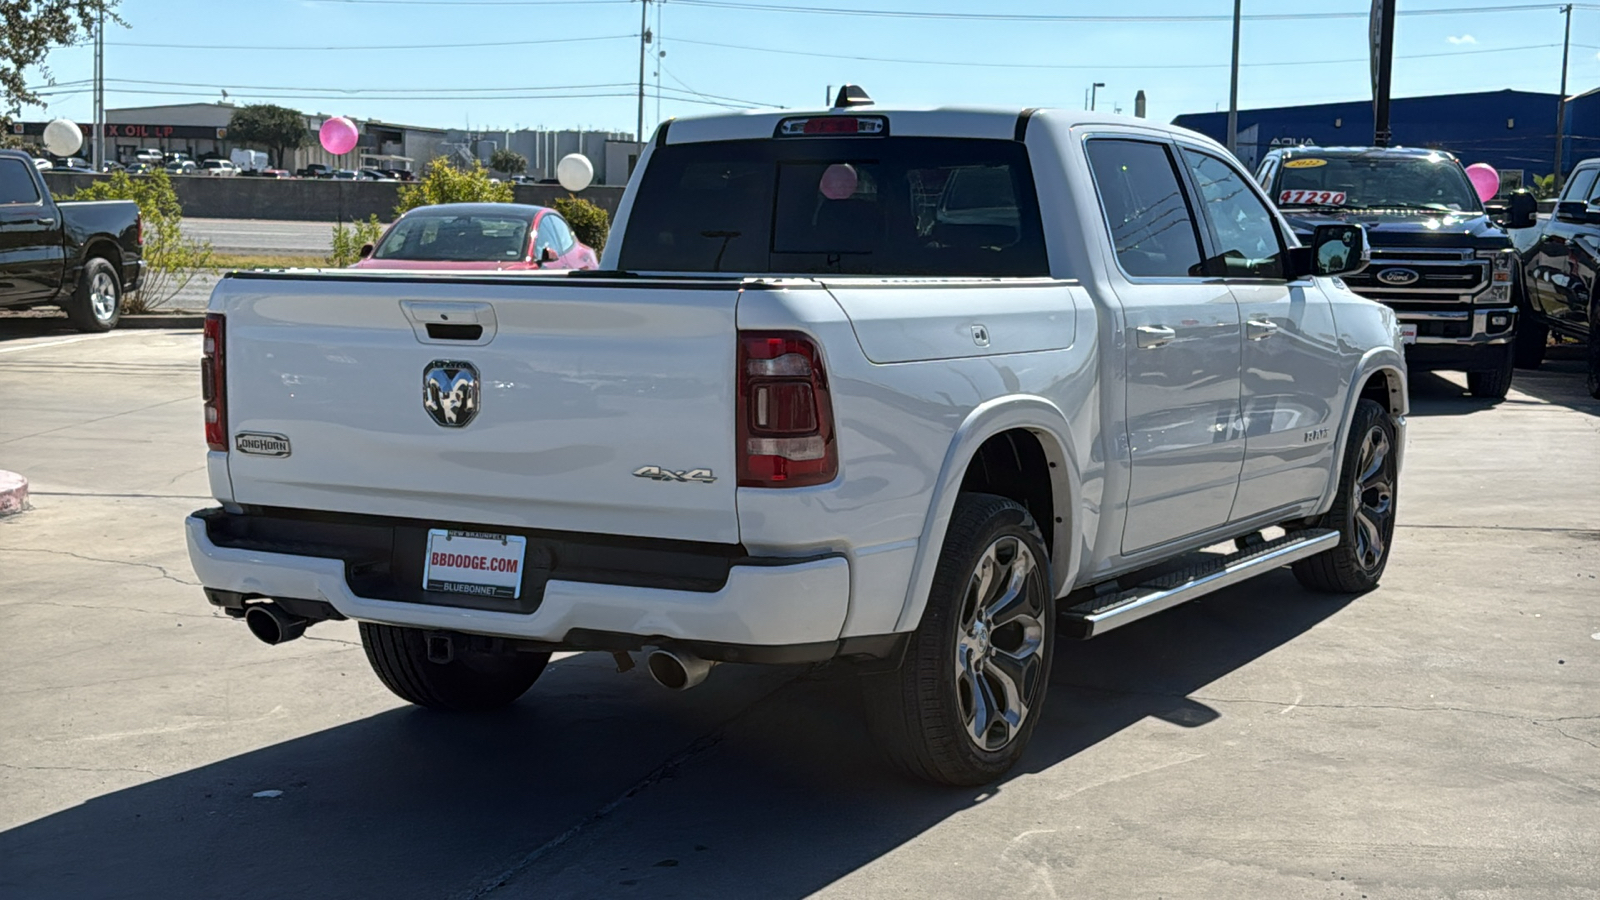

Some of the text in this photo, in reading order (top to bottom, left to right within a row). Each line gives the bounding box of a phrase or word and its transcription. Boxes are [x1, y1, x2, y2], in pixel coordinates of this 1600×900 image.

[124, 124, 149, 137] OIL
[155, 126, 173, 137] LP
[1270, 137, 1315, 145] AQUA
[1280, 190, 1346, 206] 47290
[431, 552, 518, 573] BBDODGE.COM
[443, 582, 497, 595] BLUEBONNET
